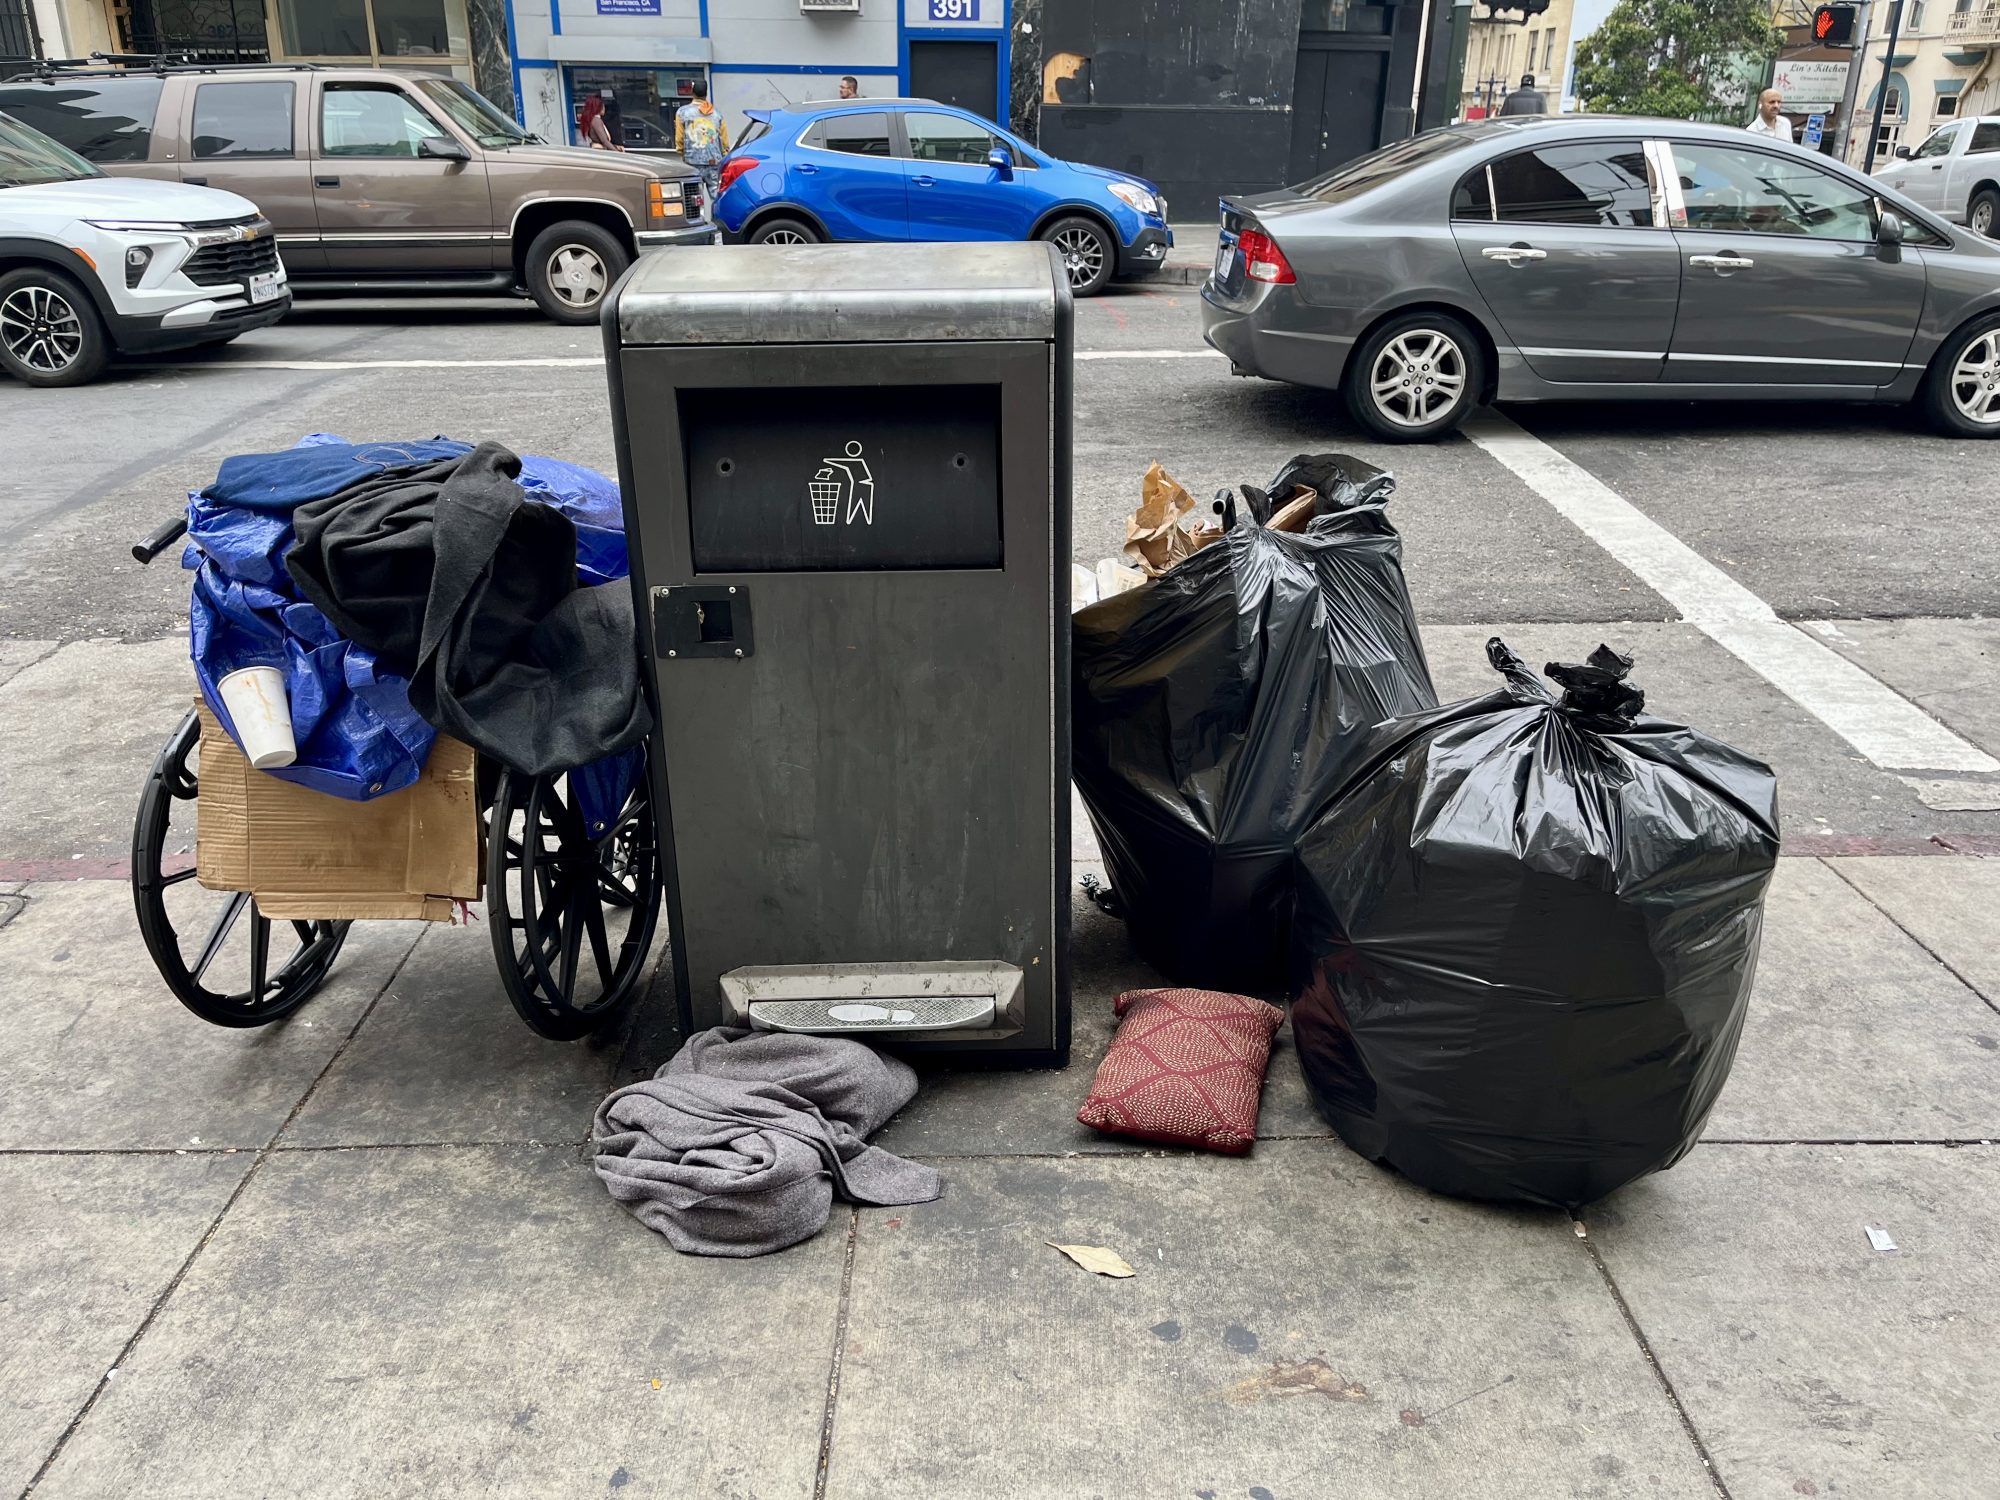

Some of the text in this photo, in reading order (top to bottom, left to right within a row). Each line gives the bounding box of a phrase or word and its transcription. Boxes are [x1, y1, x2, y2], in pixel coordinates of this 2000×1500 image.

[933, 0, 972, 18] 391
[1790, 63, 1848, 73] Lin's Kitchen
